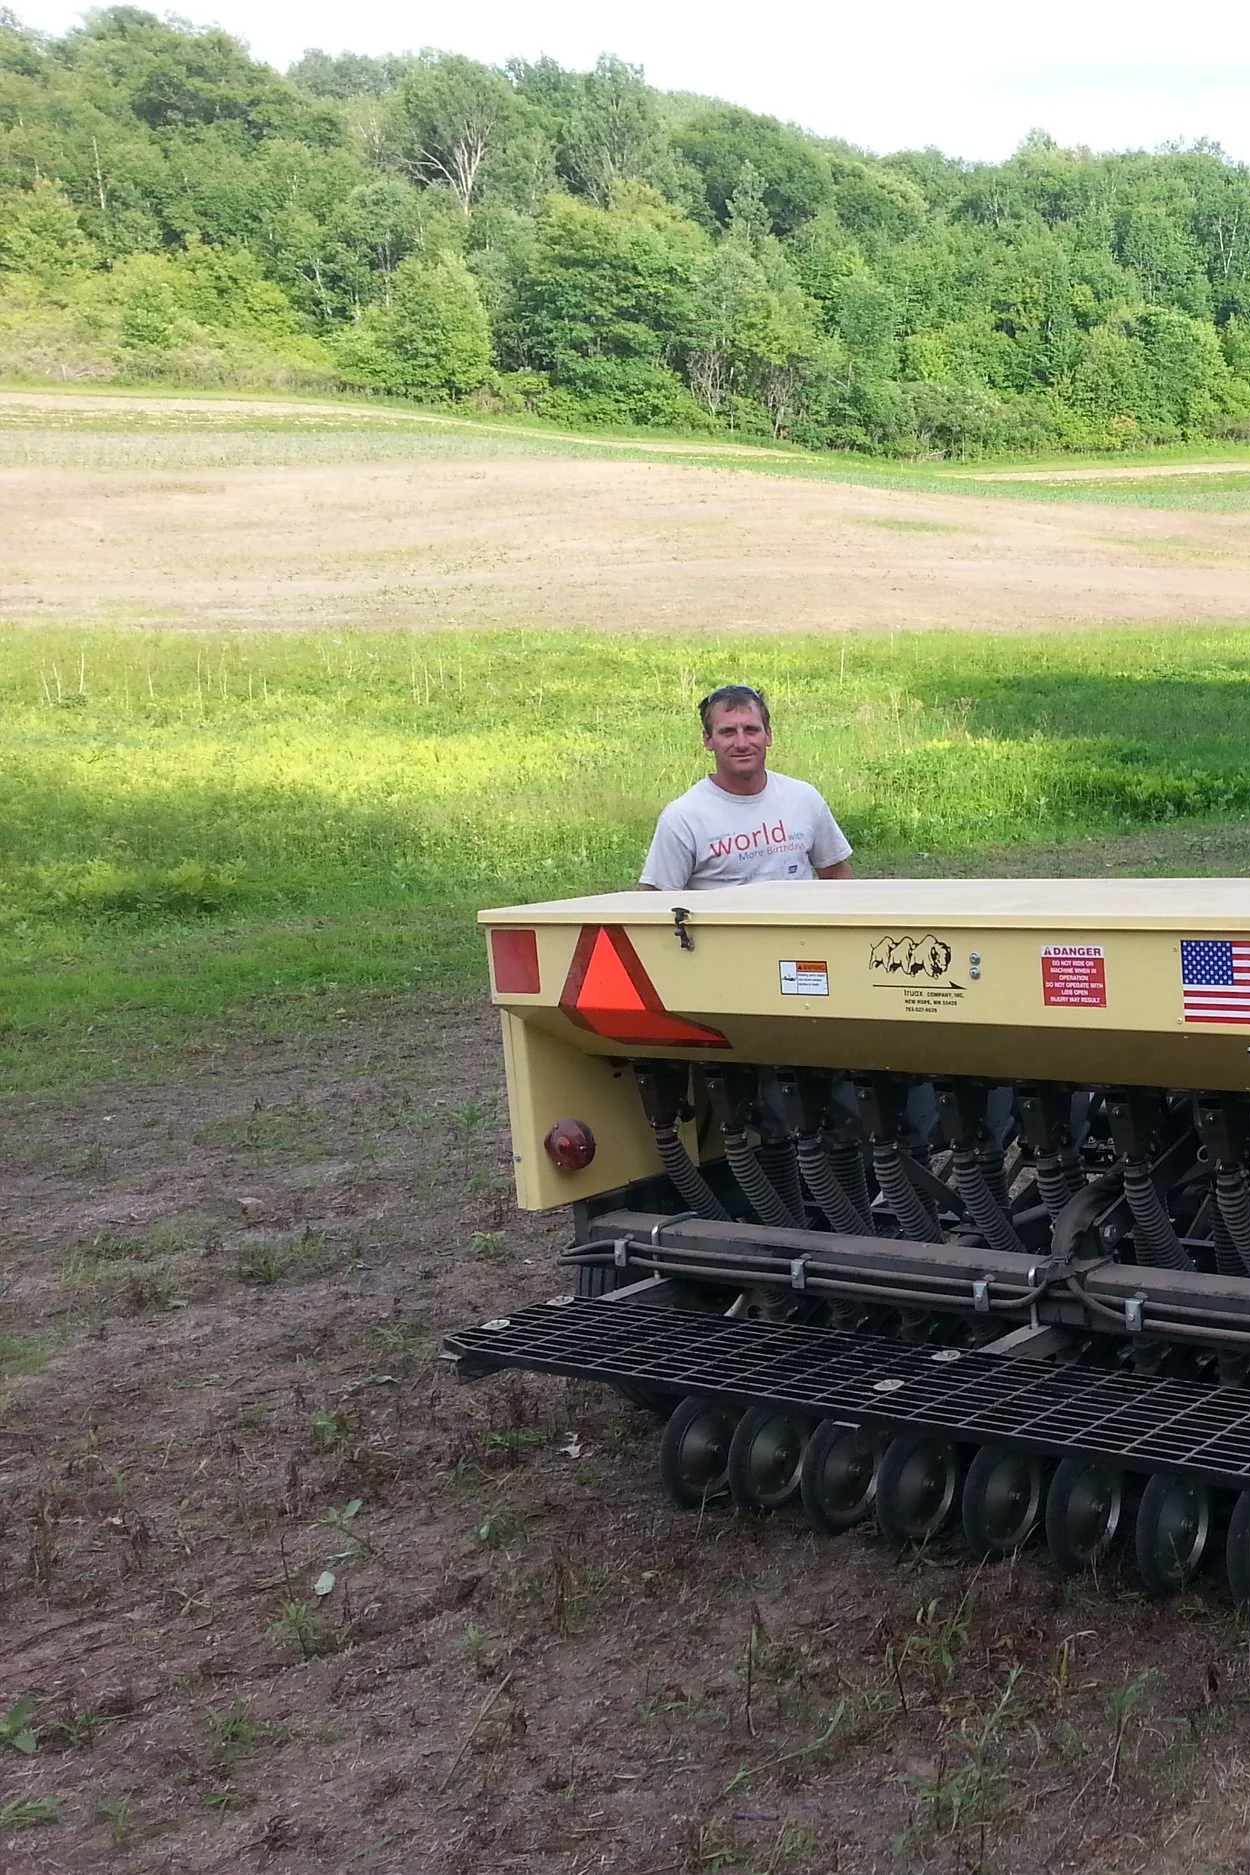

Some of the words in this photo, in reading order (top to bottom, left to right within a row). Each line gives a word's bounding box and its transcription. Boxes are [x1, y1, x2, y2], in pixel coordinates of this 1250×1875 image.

[710, 819, 786, 857] world
[788, 833, 804, 841] with
[738, 850, 764, 861] More
[766, 843, 805, 855] Birthdays
[1053, 947, 1102, 956] DANGER
